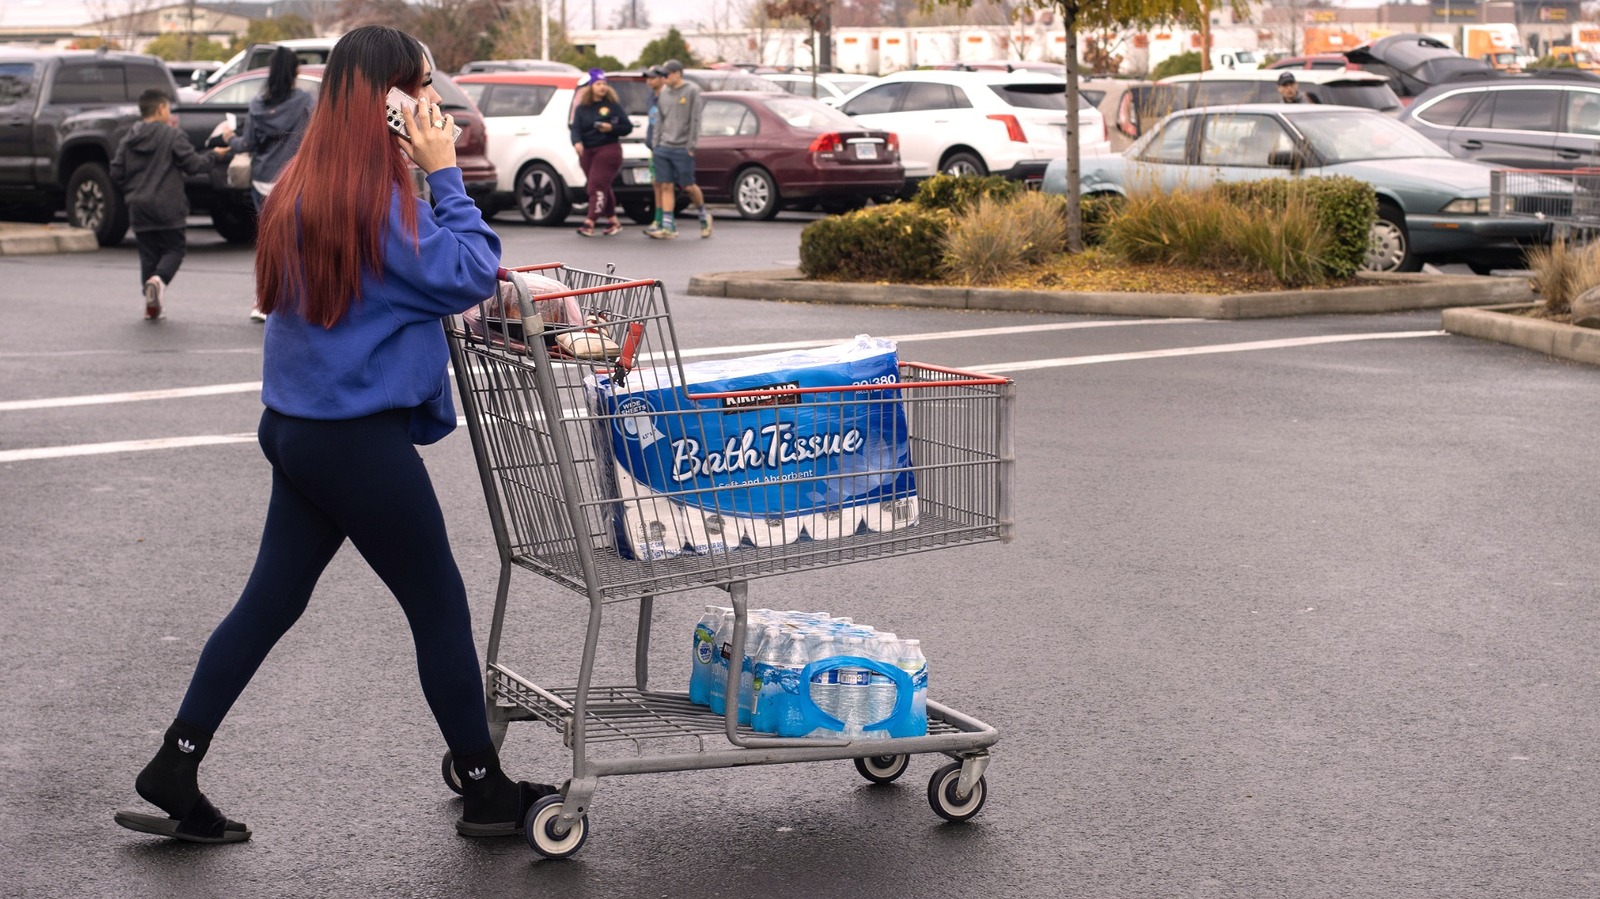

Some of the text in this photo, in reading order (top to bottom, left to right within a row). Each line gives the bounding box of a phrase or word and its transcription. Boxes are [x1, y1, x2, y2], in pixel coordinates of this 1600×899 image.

[622, 400, 641, 410] WIDE
[672, 423, 863, 482] Bath Tissue
[741, 477, 760, 486] and
[764, 469, 814, 484] Absorbent
